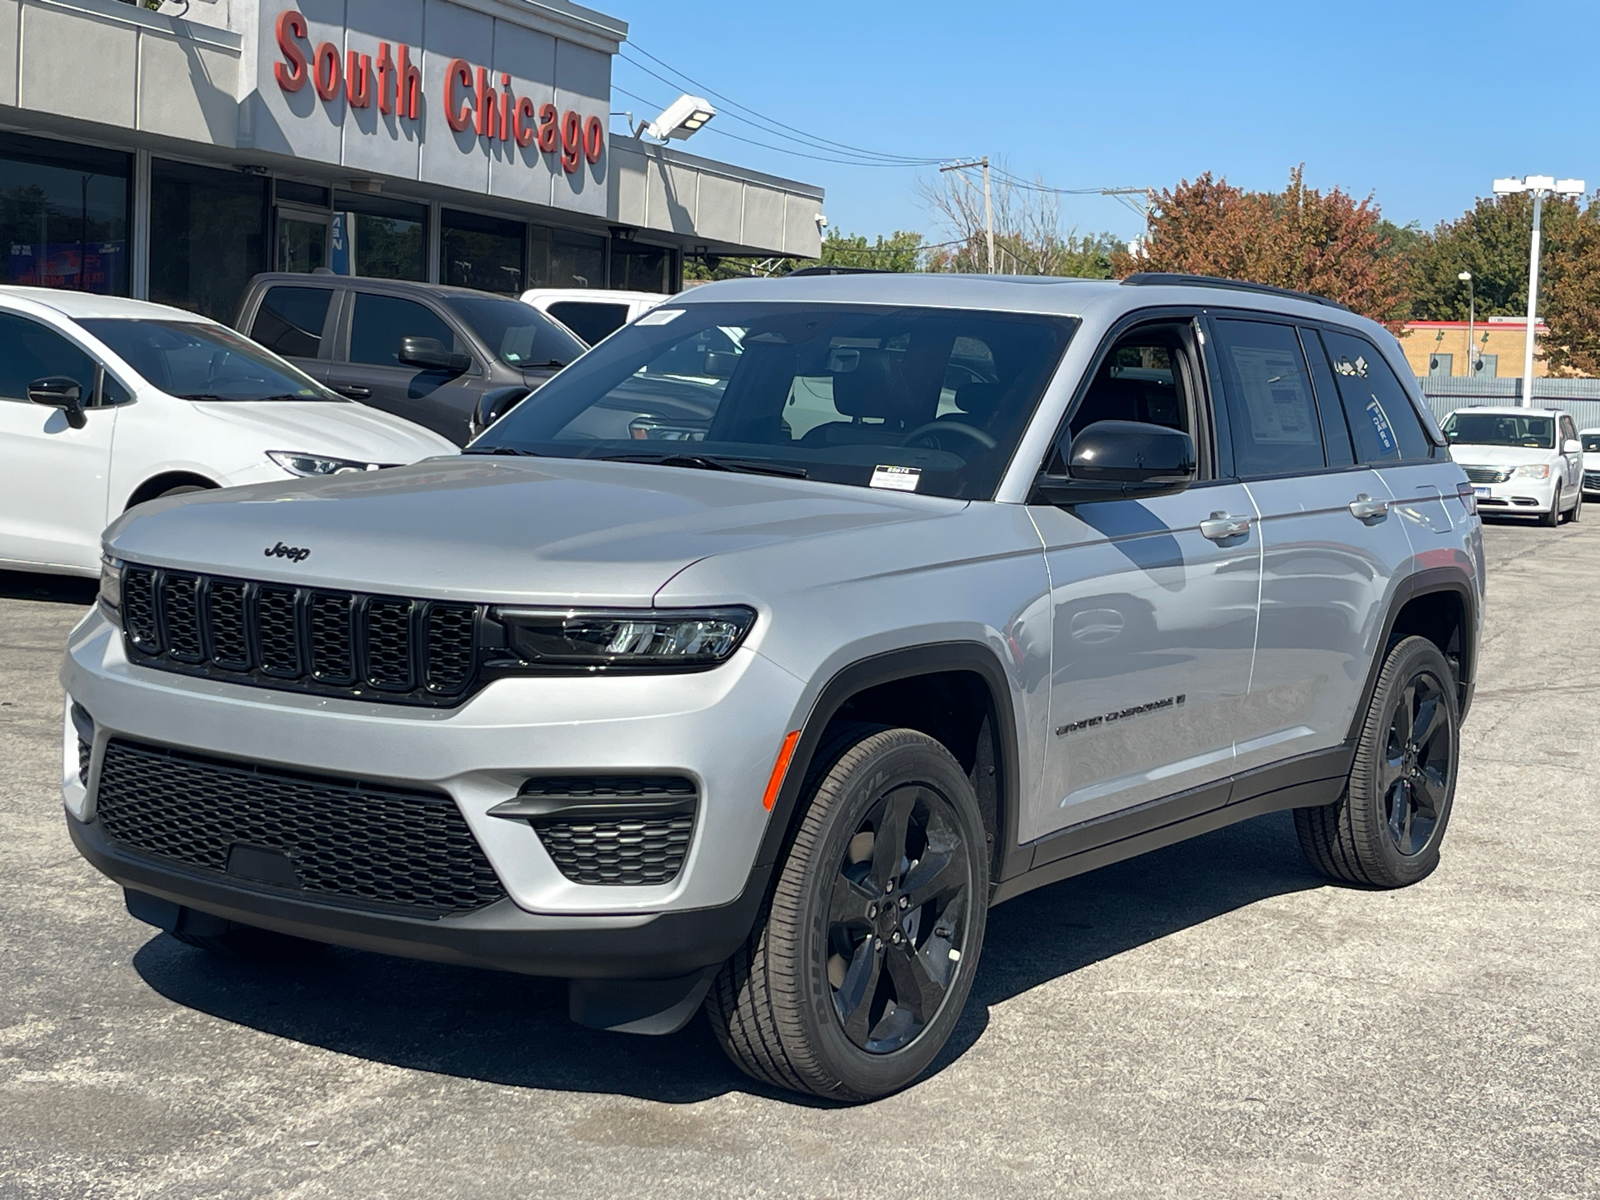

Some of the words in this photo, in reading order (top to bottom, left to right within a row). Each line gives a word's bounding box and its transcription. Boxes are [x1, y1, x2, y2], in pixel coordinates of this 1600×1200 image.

[274, 10, 422, 120] South
[444, 58, 604, 174] Chicago
[264, 541, 311, 563] Jeep
